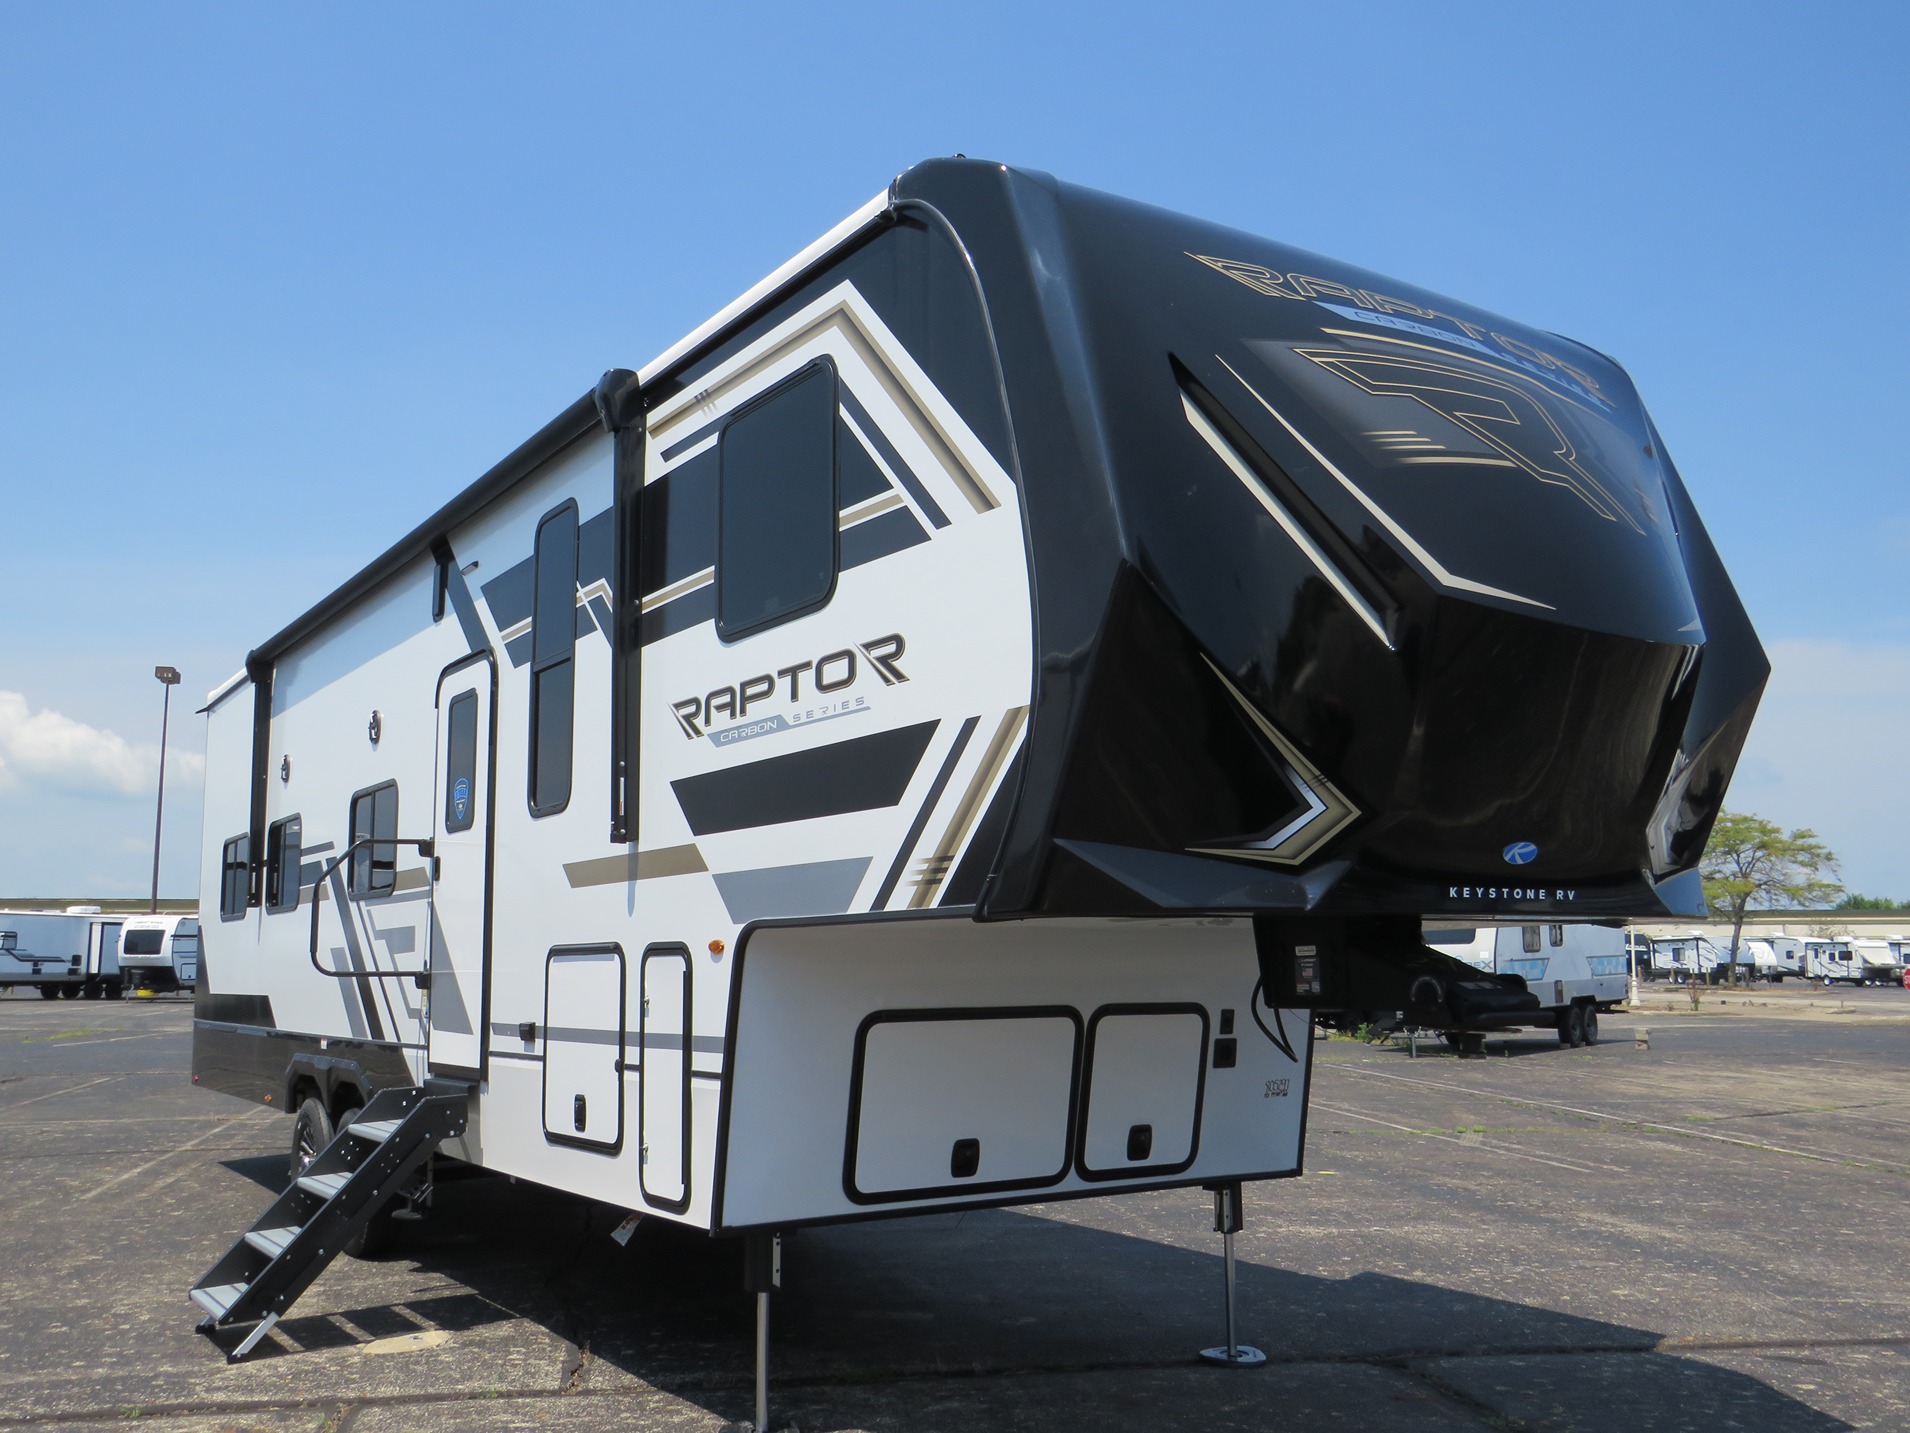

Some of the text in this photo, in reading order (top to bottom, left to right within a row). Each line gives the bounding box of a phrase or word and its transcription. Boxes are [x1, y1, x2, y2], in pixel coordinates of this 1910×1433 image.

[1184, 251, 1616, 408] RAPTOR
[667, 632, 910, 740] RAPTOR
[719, 696, 865, 743] CARBON SERIES
[1449, 887, 1575, 900] KEYSTONE RV
